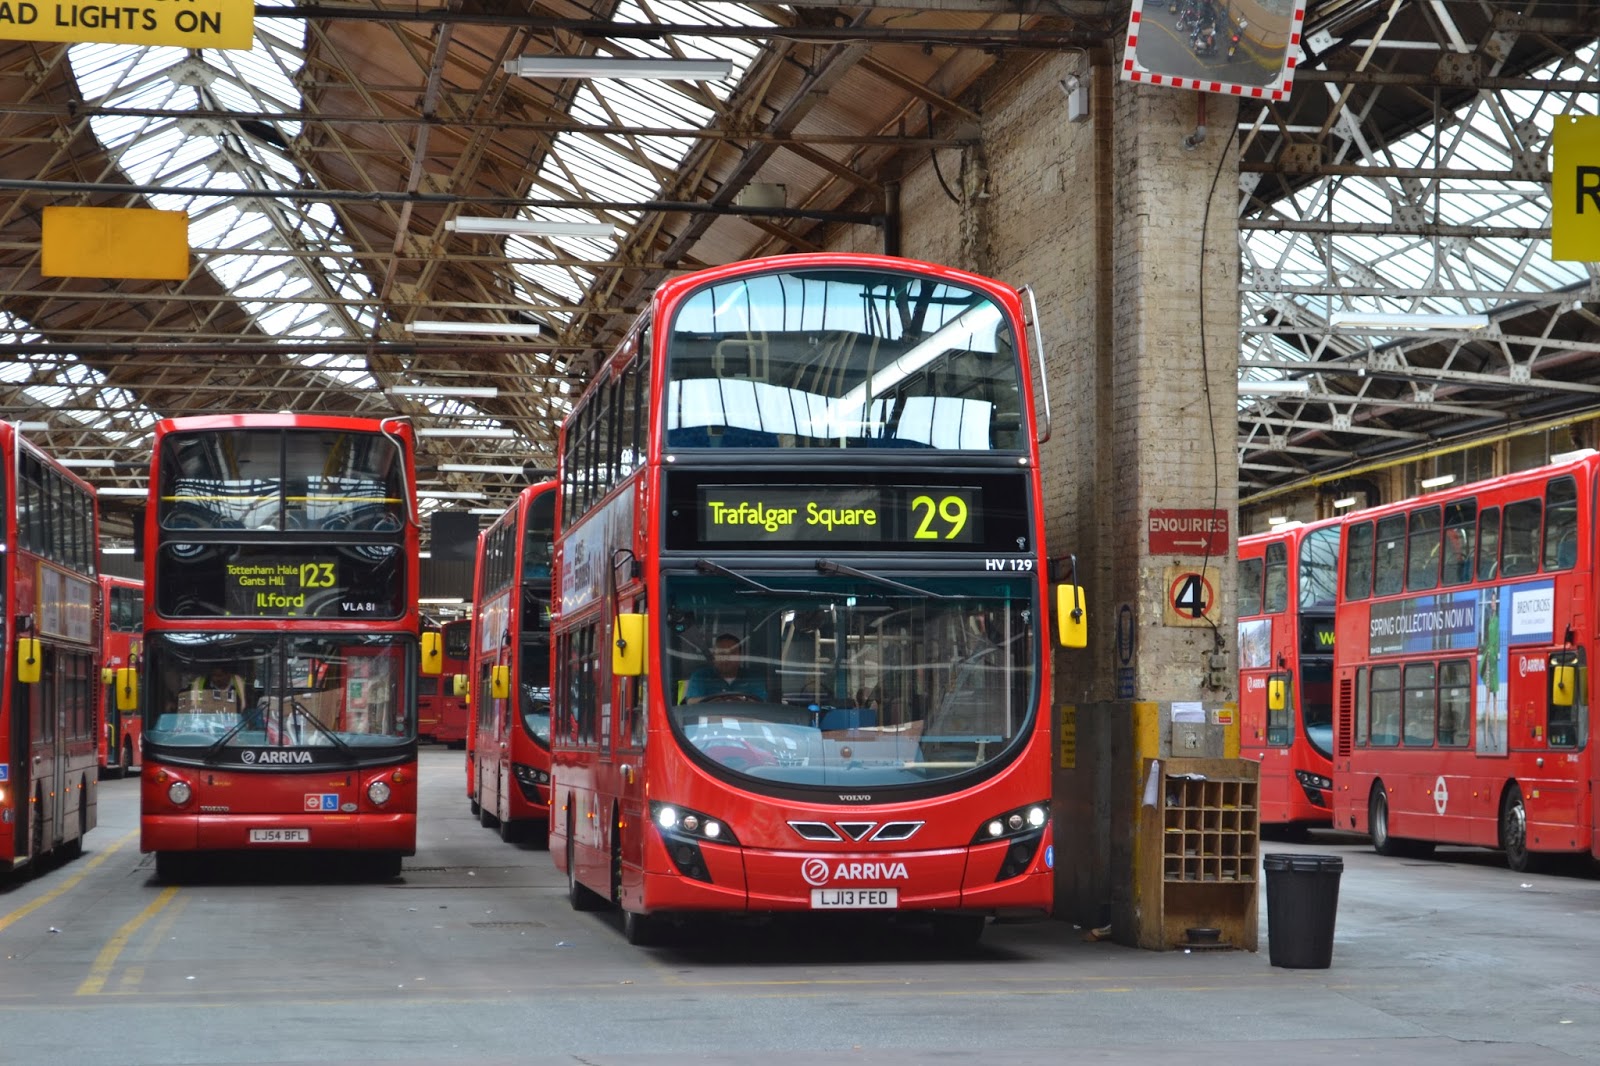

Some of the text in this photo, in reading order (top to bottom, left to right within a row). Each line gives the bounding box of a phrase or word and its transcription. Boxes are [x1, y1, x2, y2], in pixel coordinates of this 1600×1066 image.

[55, 4, 157, 31] LIGHTS
[175, 10, 221, 34] ON
[1576, 165, 1600, 215] R
[708, 501, 877, 532] Trafalgar Square
[911, 495, 968, 540] 29
[1149, 518, 1227, 533] ENQUIRIES
[226, 565, 298, 575] Tottenham Hale
[985, 559, 1033, 571] HV 129
[239, 576, 286, 586] Gants Hill
[300, 563, 336, 588] 123
[257, 593, 305, 607] Ilford
[1175, 574, 1206, 618] 4
[342, 602, 375, 611] VLA 81
[1370, 607, 1474, 638] SPRING COLLECTIONS NOW IN
[1527, 658, 1546, 672] ARRIVA
[258, 751, 313, 764] ARRIVA
[253, 831, 304, 841] LJ54 BFL
[833, 862, 909, 880] ARRIVA
[821, 890, 855, 905] LJ13
